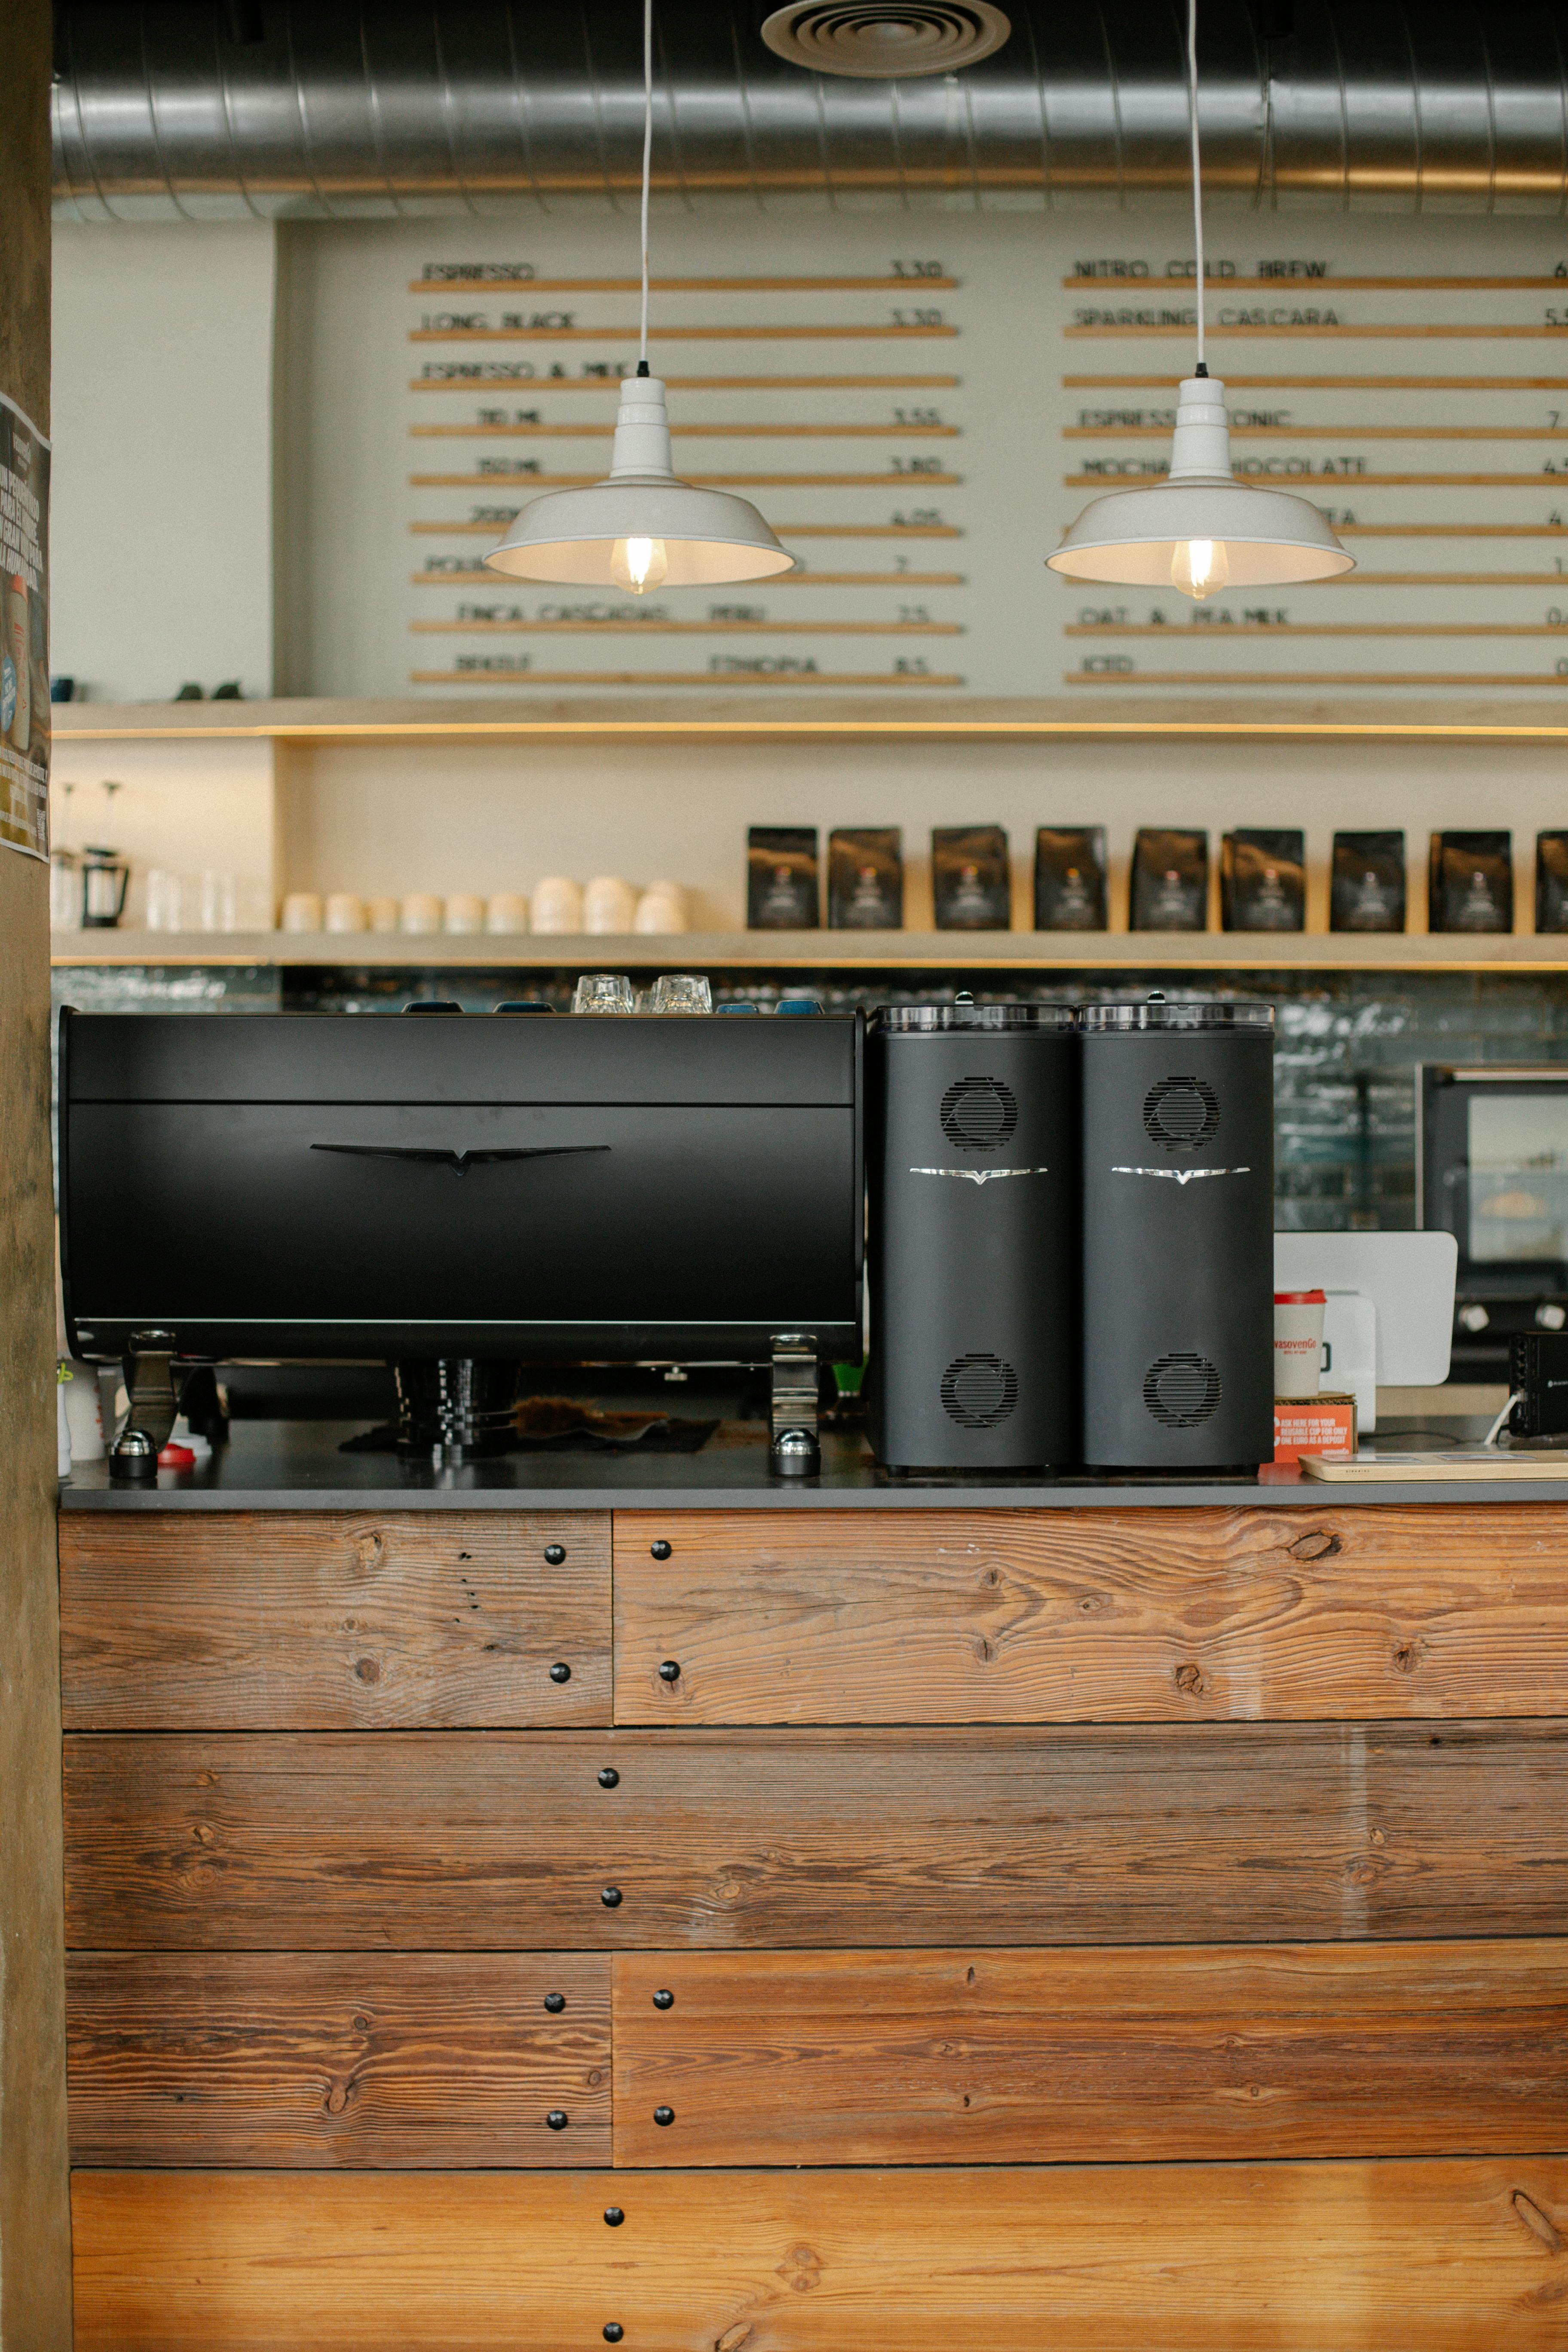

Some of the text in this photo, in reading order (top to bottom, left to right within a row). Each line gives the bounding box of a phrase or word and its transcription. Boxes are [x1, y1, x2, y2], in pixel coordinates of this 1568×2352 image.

[422, 263, 533, 280] ESPRESSO
[1074, 260, 1326, 278] NITRO COLD BREW
[422, 312, 575, 329] LONG BLACK
[1075, 308, 1339, 325] SPARKLING CASCARA
[422, 362, 534, 378] ESPRESSO
[1080, 410, 1292, 426] ESPRESS ONIC
[1231, 457, 1367, 474] HOCOLATE
[1079, 607, 1127, 624] OAT
[710, 655, 817, 673] ETHIOPIA
[1083, 654, 1134, 671] ICED
[1308, 1418, 1320, 1427] FOR
[1320, 1418, 1335, 1426] YOUR
[1333, 1427, 1348, 1435] ONLY
